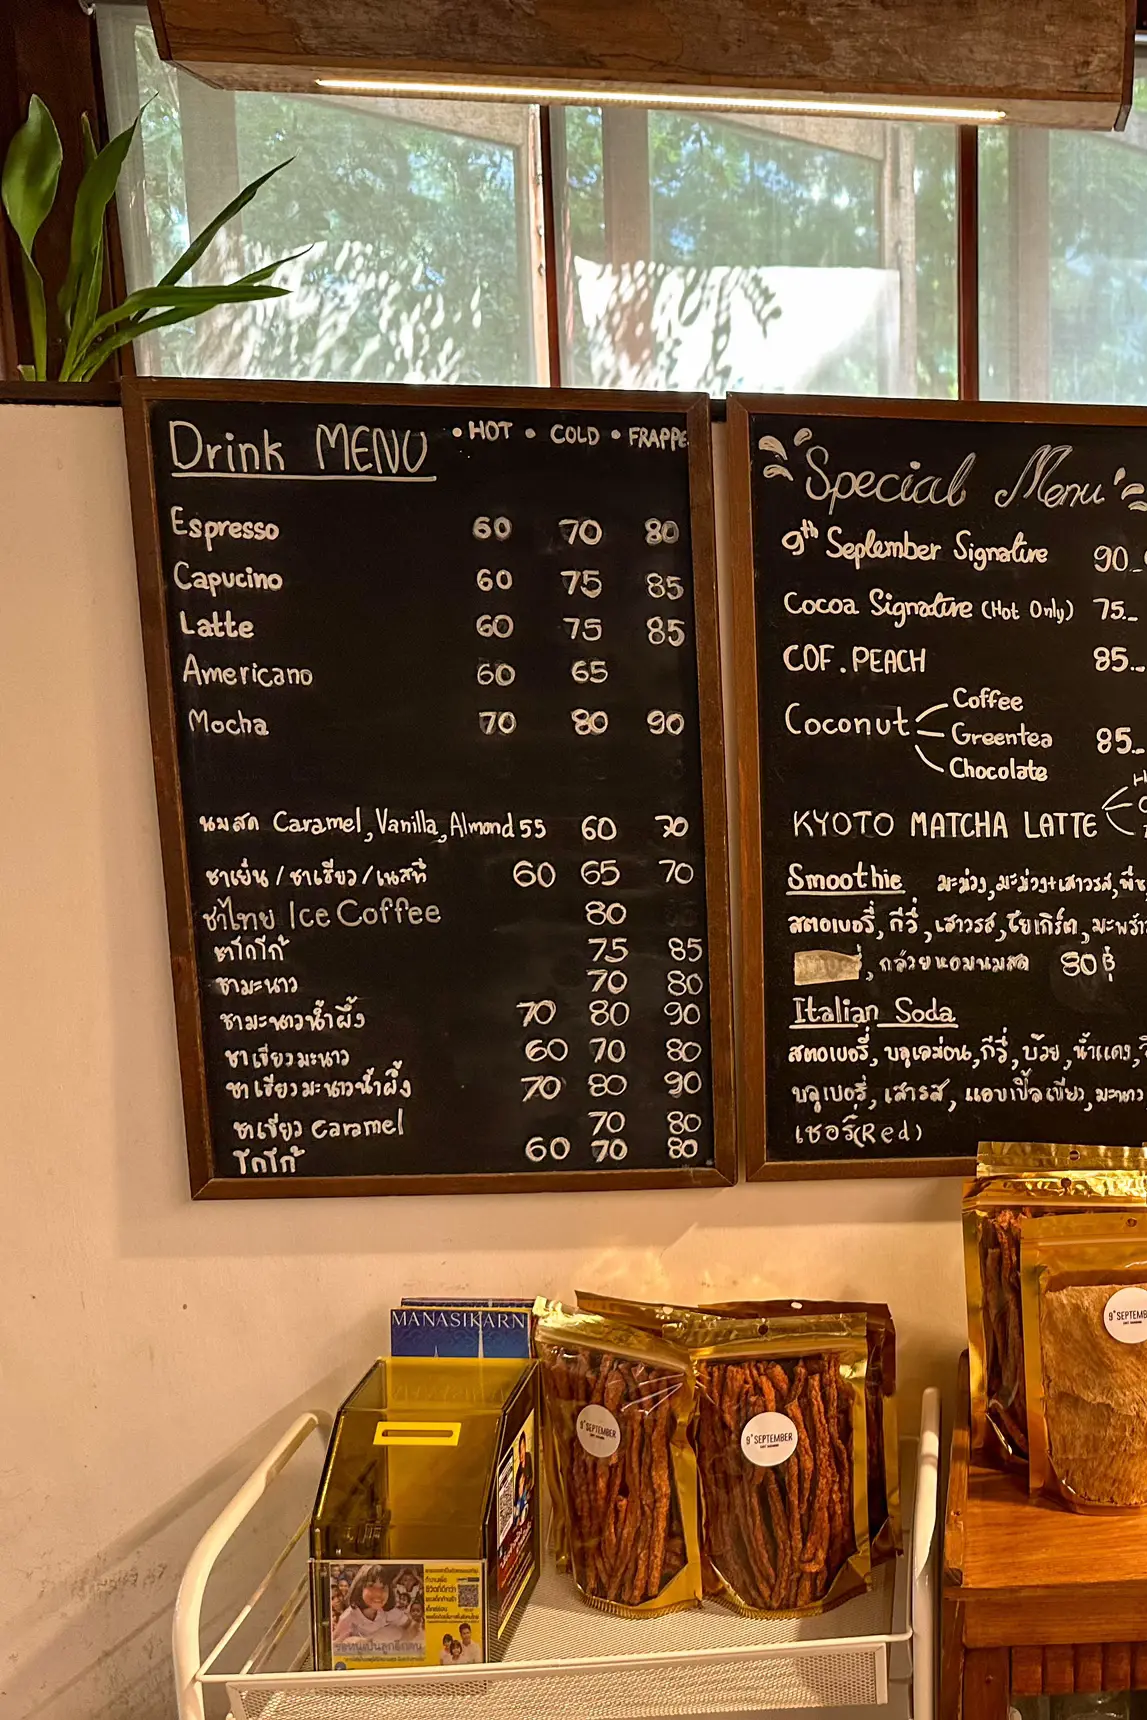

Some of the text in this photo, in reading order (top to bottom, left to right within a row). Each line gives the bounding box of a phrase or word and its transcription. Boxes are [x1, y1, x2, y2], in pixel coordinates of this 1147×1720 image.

[169, 420, 687, 474] Drink MENU HOT COLD FRAPPE
[805, 444, 1106, 515] Special Menu
[170, 505, 679, 552] Espresso 60 70 80
[825, 525, 942, 570] September
[953, 529, 1049, 572] Signature
[173, 560, 684, 600] Capucino 60 75 85
[783, 591, 860, 615] Cocoa
[869, 588, 973, 629] Signature
[981, 599, 1021, 621] (Hot
[1029, 597, 1074, 625] Only)
[179, 609, 685, 647] Latte 60 75 85
[182, 653, 609, 688] Americano 60 65
[188, 708, 685, 736] Mocha 70 80 90
[784, 687, 1024, 737] Coconut Coffee
[951, 721, 1053, 749] Greentea
[949, 756, 1049, 782] Chocolate
[450, 811, 516, 838] Almond
[519, 818, 547, 839] 55
[581, 815, 617, 841] 60
[654, 814, 689, 838] 70
[793, 809, 1098, 839] KYOTO MATCHA LATTE
[512, 860, 556, 888] 60
[580, 859, 621, 886] 65
[658, 859, 694, 885] 70
[787, 860, 904, 891] Smoothie
[289, 900, 331, 930] Ice
[336, 897, 442, 927] Coffee
[585, 900, 627, 926] 80
[587, 937, 629, 963] 75
[668, 937, 703, 963] 85
[1060, 951, 1098, 977] 80
[587, 968, 628, 995] 70
[667, 970, 703, 997] 80
[516, 999, 557, 1027] 70
[588, 999, 630, 1027] 80
[663, 1001, 701, 1026] 90
[792, 996, 956, 1023] Italian Soda
[525, 1038, 569, 1062] 60
[589, 1037, 626, 1063] 70
[665, 1038, 702, 1063] 80
[520, 1075, 562, 1102] 70
[587, 1073, 628, 1097] 80
[663, 1070, 702, 1095] 90
[311, 1107, 404, 1139] Caramel
[587, 1111, 626, 1136] 70
[666, 1110, 702, 1135] 80
[525, 1136, 571, 1162] 60
[590, 1138, 628, 1163] 70
[667, 1136, 698, 1159] 80
[392, 1310, 526, 1329] MANASIKARN
[586, 1422, 617, 1439] SEPTEMBER
[754, 1432, 793, 1446] SEPTEMBER
